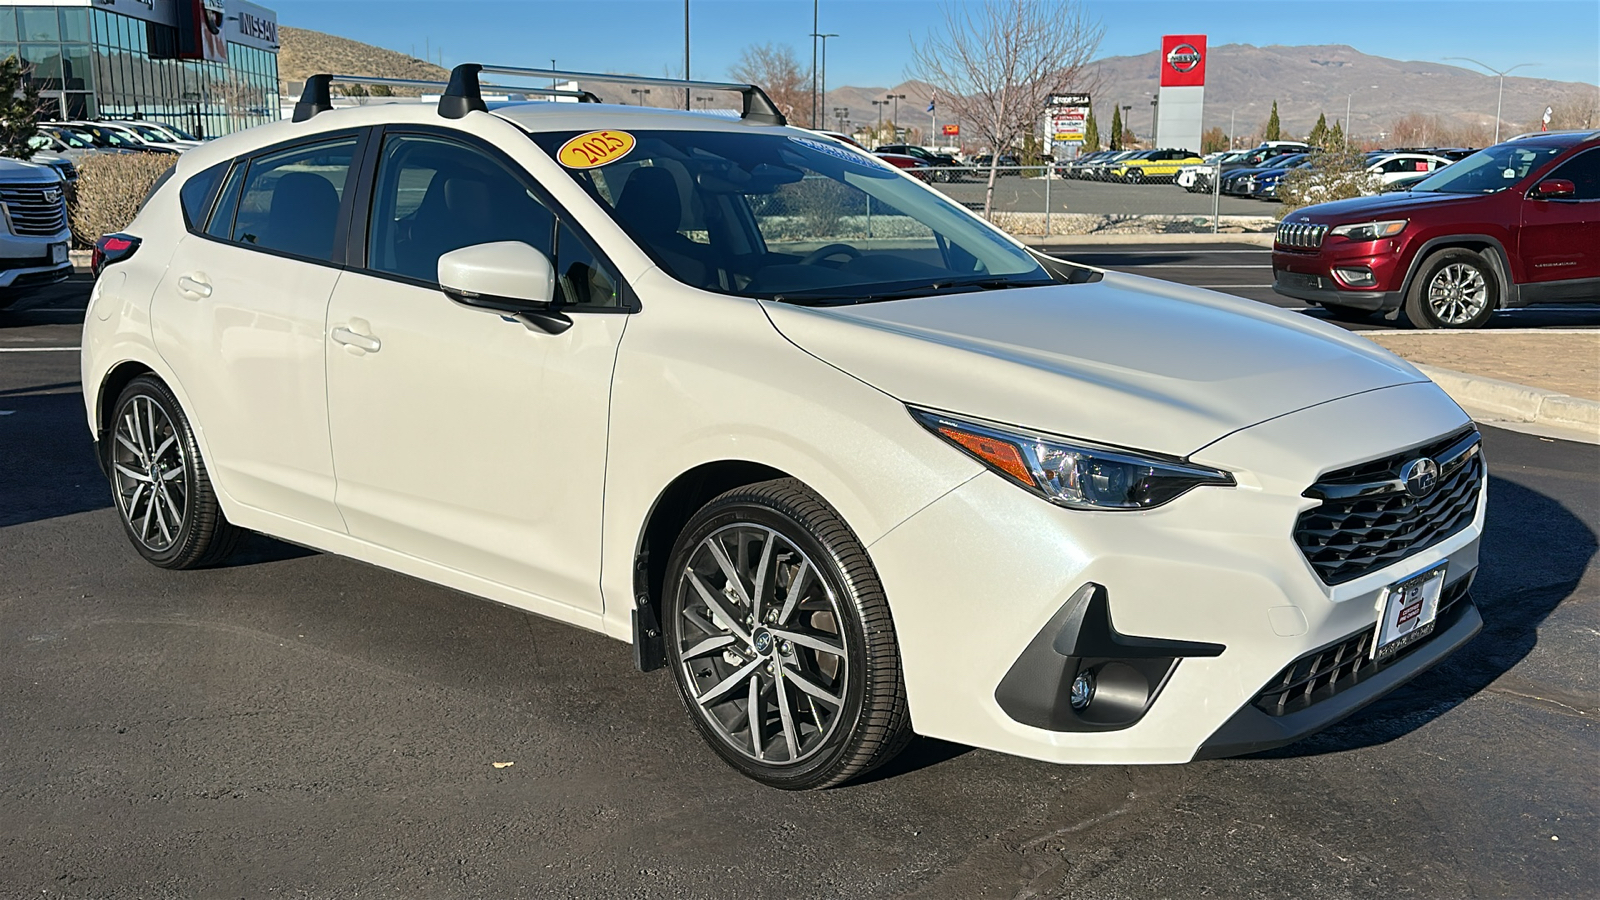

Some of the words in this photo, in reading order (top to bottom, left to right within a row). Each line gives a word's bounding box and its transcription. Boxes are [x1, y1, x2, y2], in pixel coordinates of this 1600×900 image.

[240, 12, 276, 42] NISSAN
[1170, 54, 1198, 62] NISSAN
[572, 132, 624, 164] 2025
